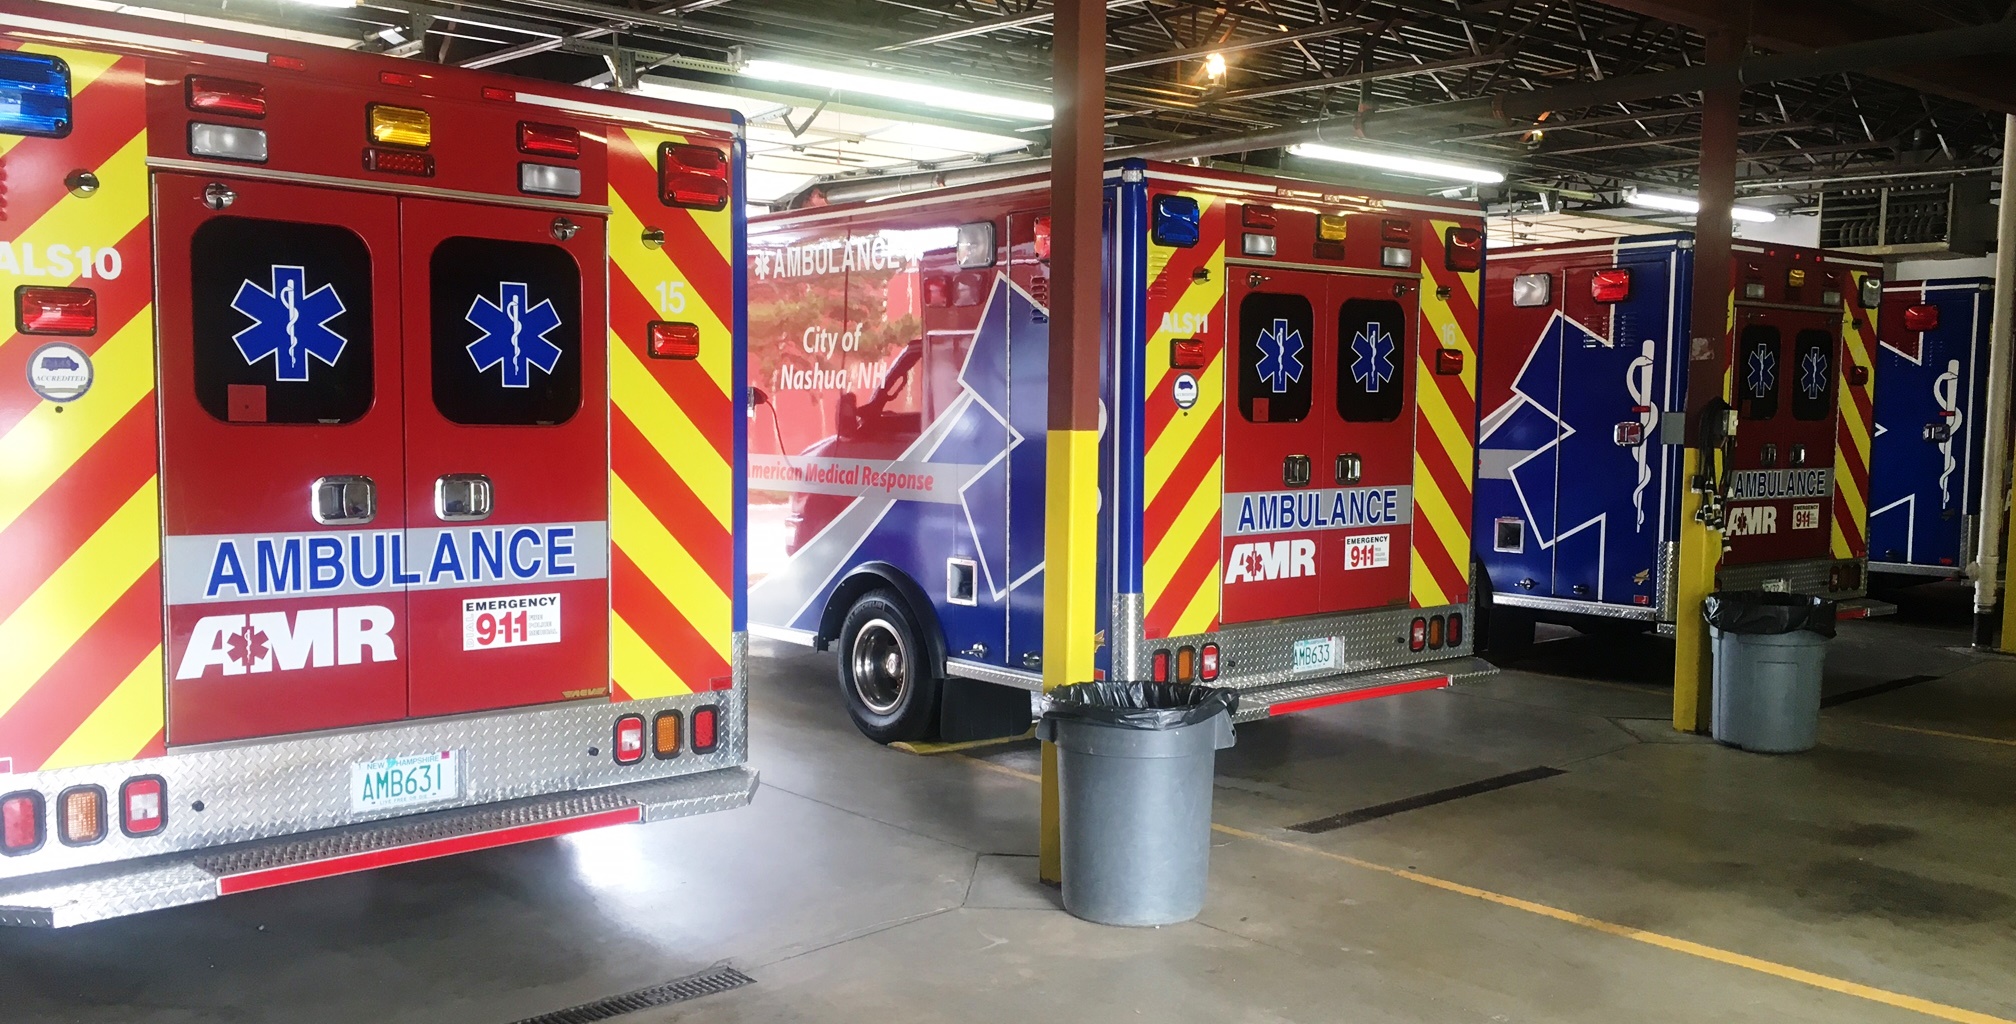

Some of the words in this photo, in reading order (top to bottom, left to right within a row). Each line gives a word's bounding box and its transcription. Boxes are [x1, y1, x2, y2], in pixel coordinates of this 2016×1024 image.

[0, 241, 122, 280] ALS10
[655, 281, 686, 314] 15
[1160, 311, 1209, 334] ALS11
[1441, 323, 1456, 346] 16
[803, 325, 837, 359] City
[841, 322, 863, 352] of
[780, 364, 851, 393] Nashua,
[858, 361, 886, 391] NH
[805, 463, 859, 485] Medical
[862, 465, 935, 492] Response
[1733, 470, 1826, 499] AMBULANCE
[1236, 488, 1398, 533] AMBULANCE
[1726, 506, 1777, 536] AMR
[1346, 536, 1388, 545] EMERGENCY
[204, 526, 579, 599] AMBULANCE
[1224, 538, 1316, 584] AMR
[466, 596, 557, 612] EMERGENCY
[175, 604, 397, 680] AMR
[476, 610, 527, 645] 9-1-1
[1294, 643, 1330, 666] AMB633
[397, 756, 439, 765] HAMPSHIRE
[362, 763, 441, 801] AMB631
